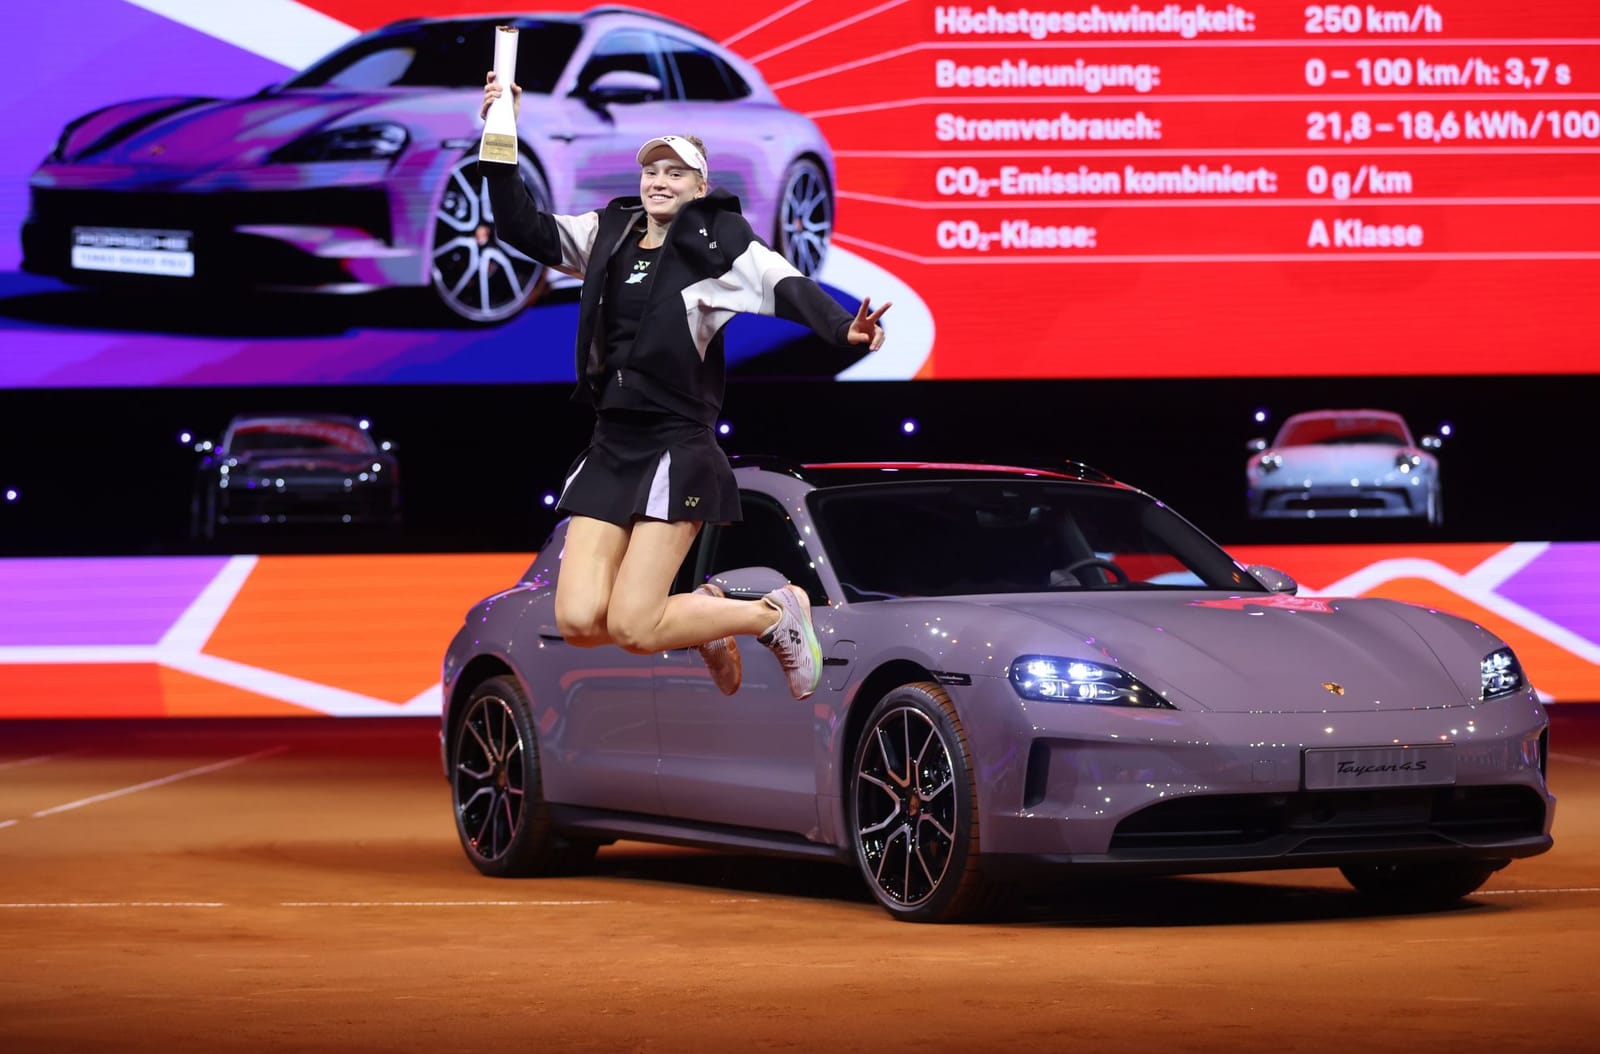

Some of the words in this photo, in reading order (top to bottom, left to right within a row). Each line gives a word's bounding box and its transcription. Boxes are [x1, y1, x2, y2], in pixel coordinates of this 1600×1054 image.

[935, 5, 1255, 40] Höchstgeschwindigkeit:
[1305, 5, 1362, 33] 250
[1366, 5, 1442, 33] km/h
[935, 59, 1160, 93] Beschleunigung:
[1305, 58, 1326, 86] 0
[1356, 58, 1413, 86] 100
[1417, 58, 1499, 86] km/h:
[1505, 57, 1550, 89] 3,7
[1555, 64, 1571, 85] s
[936, 112, 1161, 141] Stromverbrauch:
[1307, 112, 1371, 144] 21,8
[1398, 111, 1460, 143] 18,6
[1124, 165, 1277, 193] kombiniert:
[1307, 165, 1328, 194] 0
[1331, 166, 1412, 200] g/km
[1308, 219, 1330, 247] A
[1334, 219, 1423, 247] Klasse
[1337, 761, 1396, 776] Taycan
[1399, 760, 1427, 771] 4S
